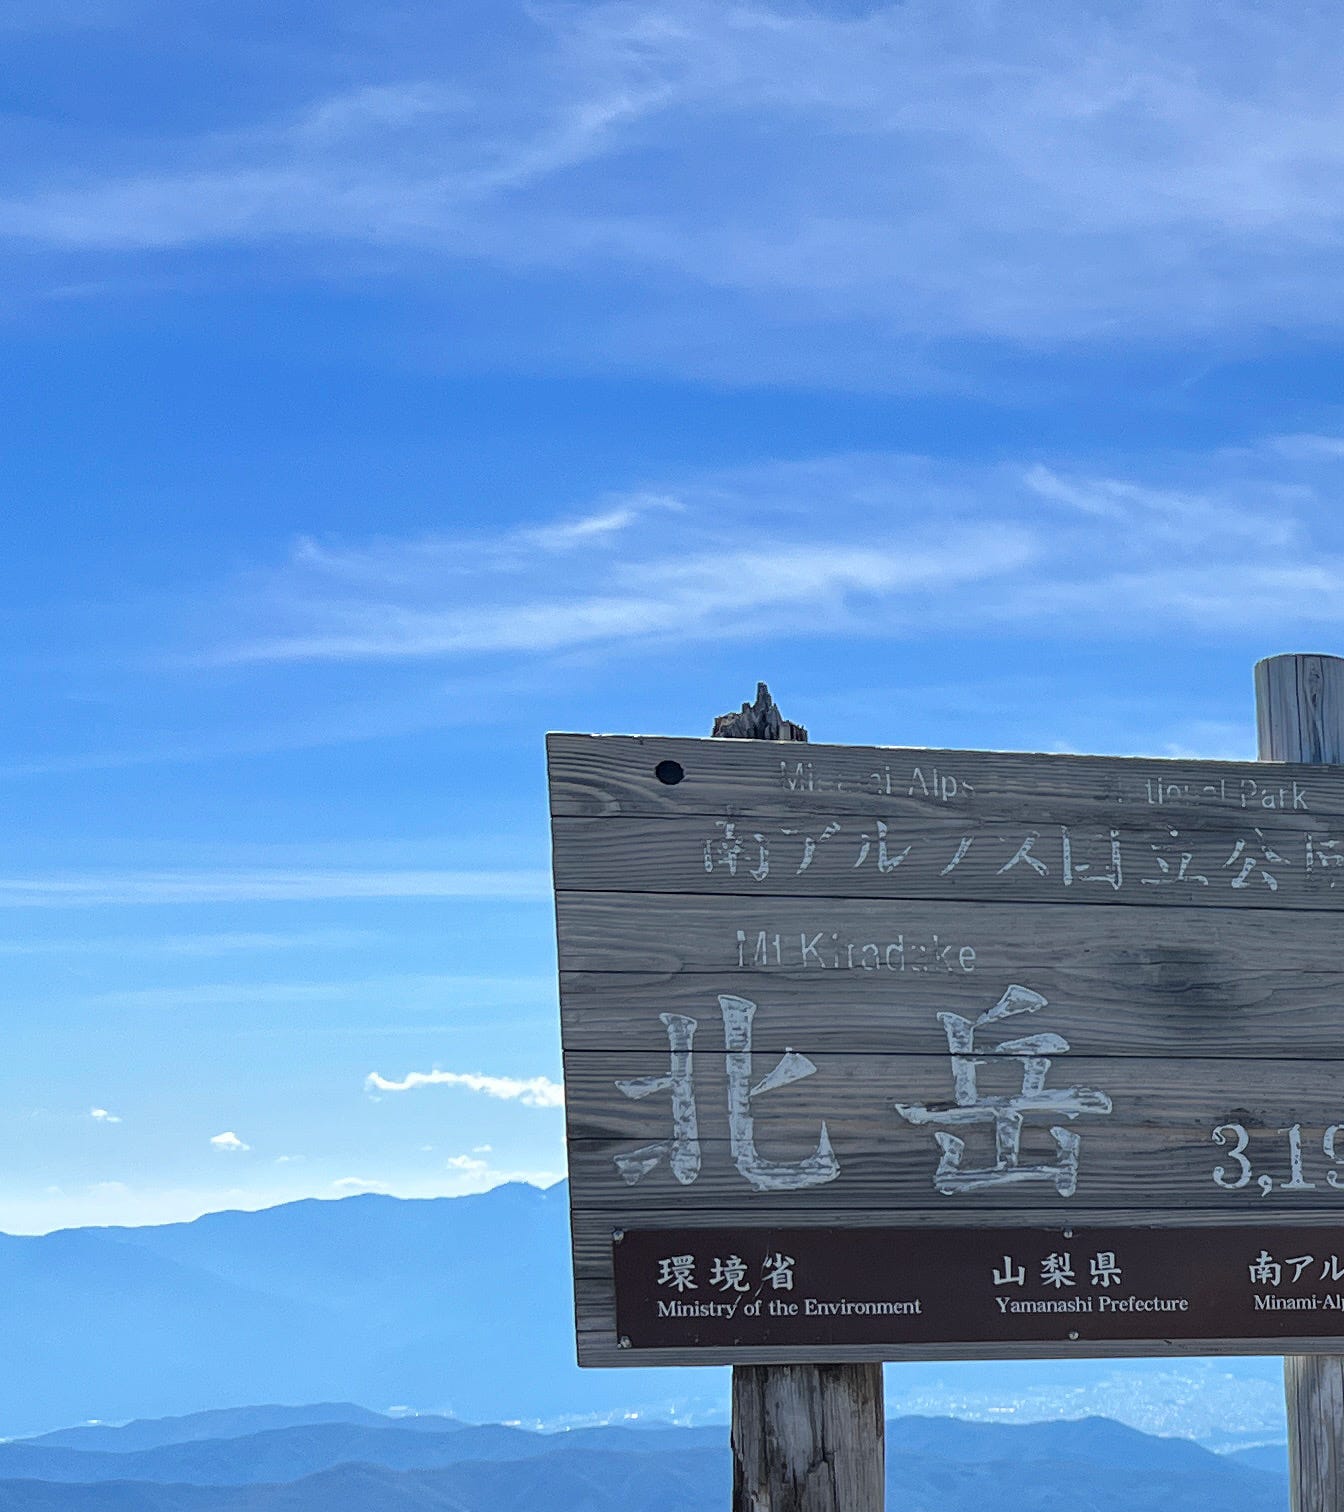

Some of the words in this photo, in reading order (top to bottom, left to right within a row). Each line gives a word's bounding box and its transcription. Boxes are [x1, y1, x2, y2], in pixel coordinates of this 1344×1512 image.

[1240, 779, 1309, 810] Park
[614, 984, 1113, 1197] 北岳
[657, 1254, 796, 1293] 環境省
[992, 1252, 1122, 1289] 山梨県
[657, 1300, 736, 1319] Ministry
[744, 1299, 763, 1316] of
[770, 1299, 798, 1316] the
[804, 1298, 922, 1316] Environment
[996, 1297, 1093, 1313] Yamanashi
[1099, 1296, 1189, 1312] Prefecture
